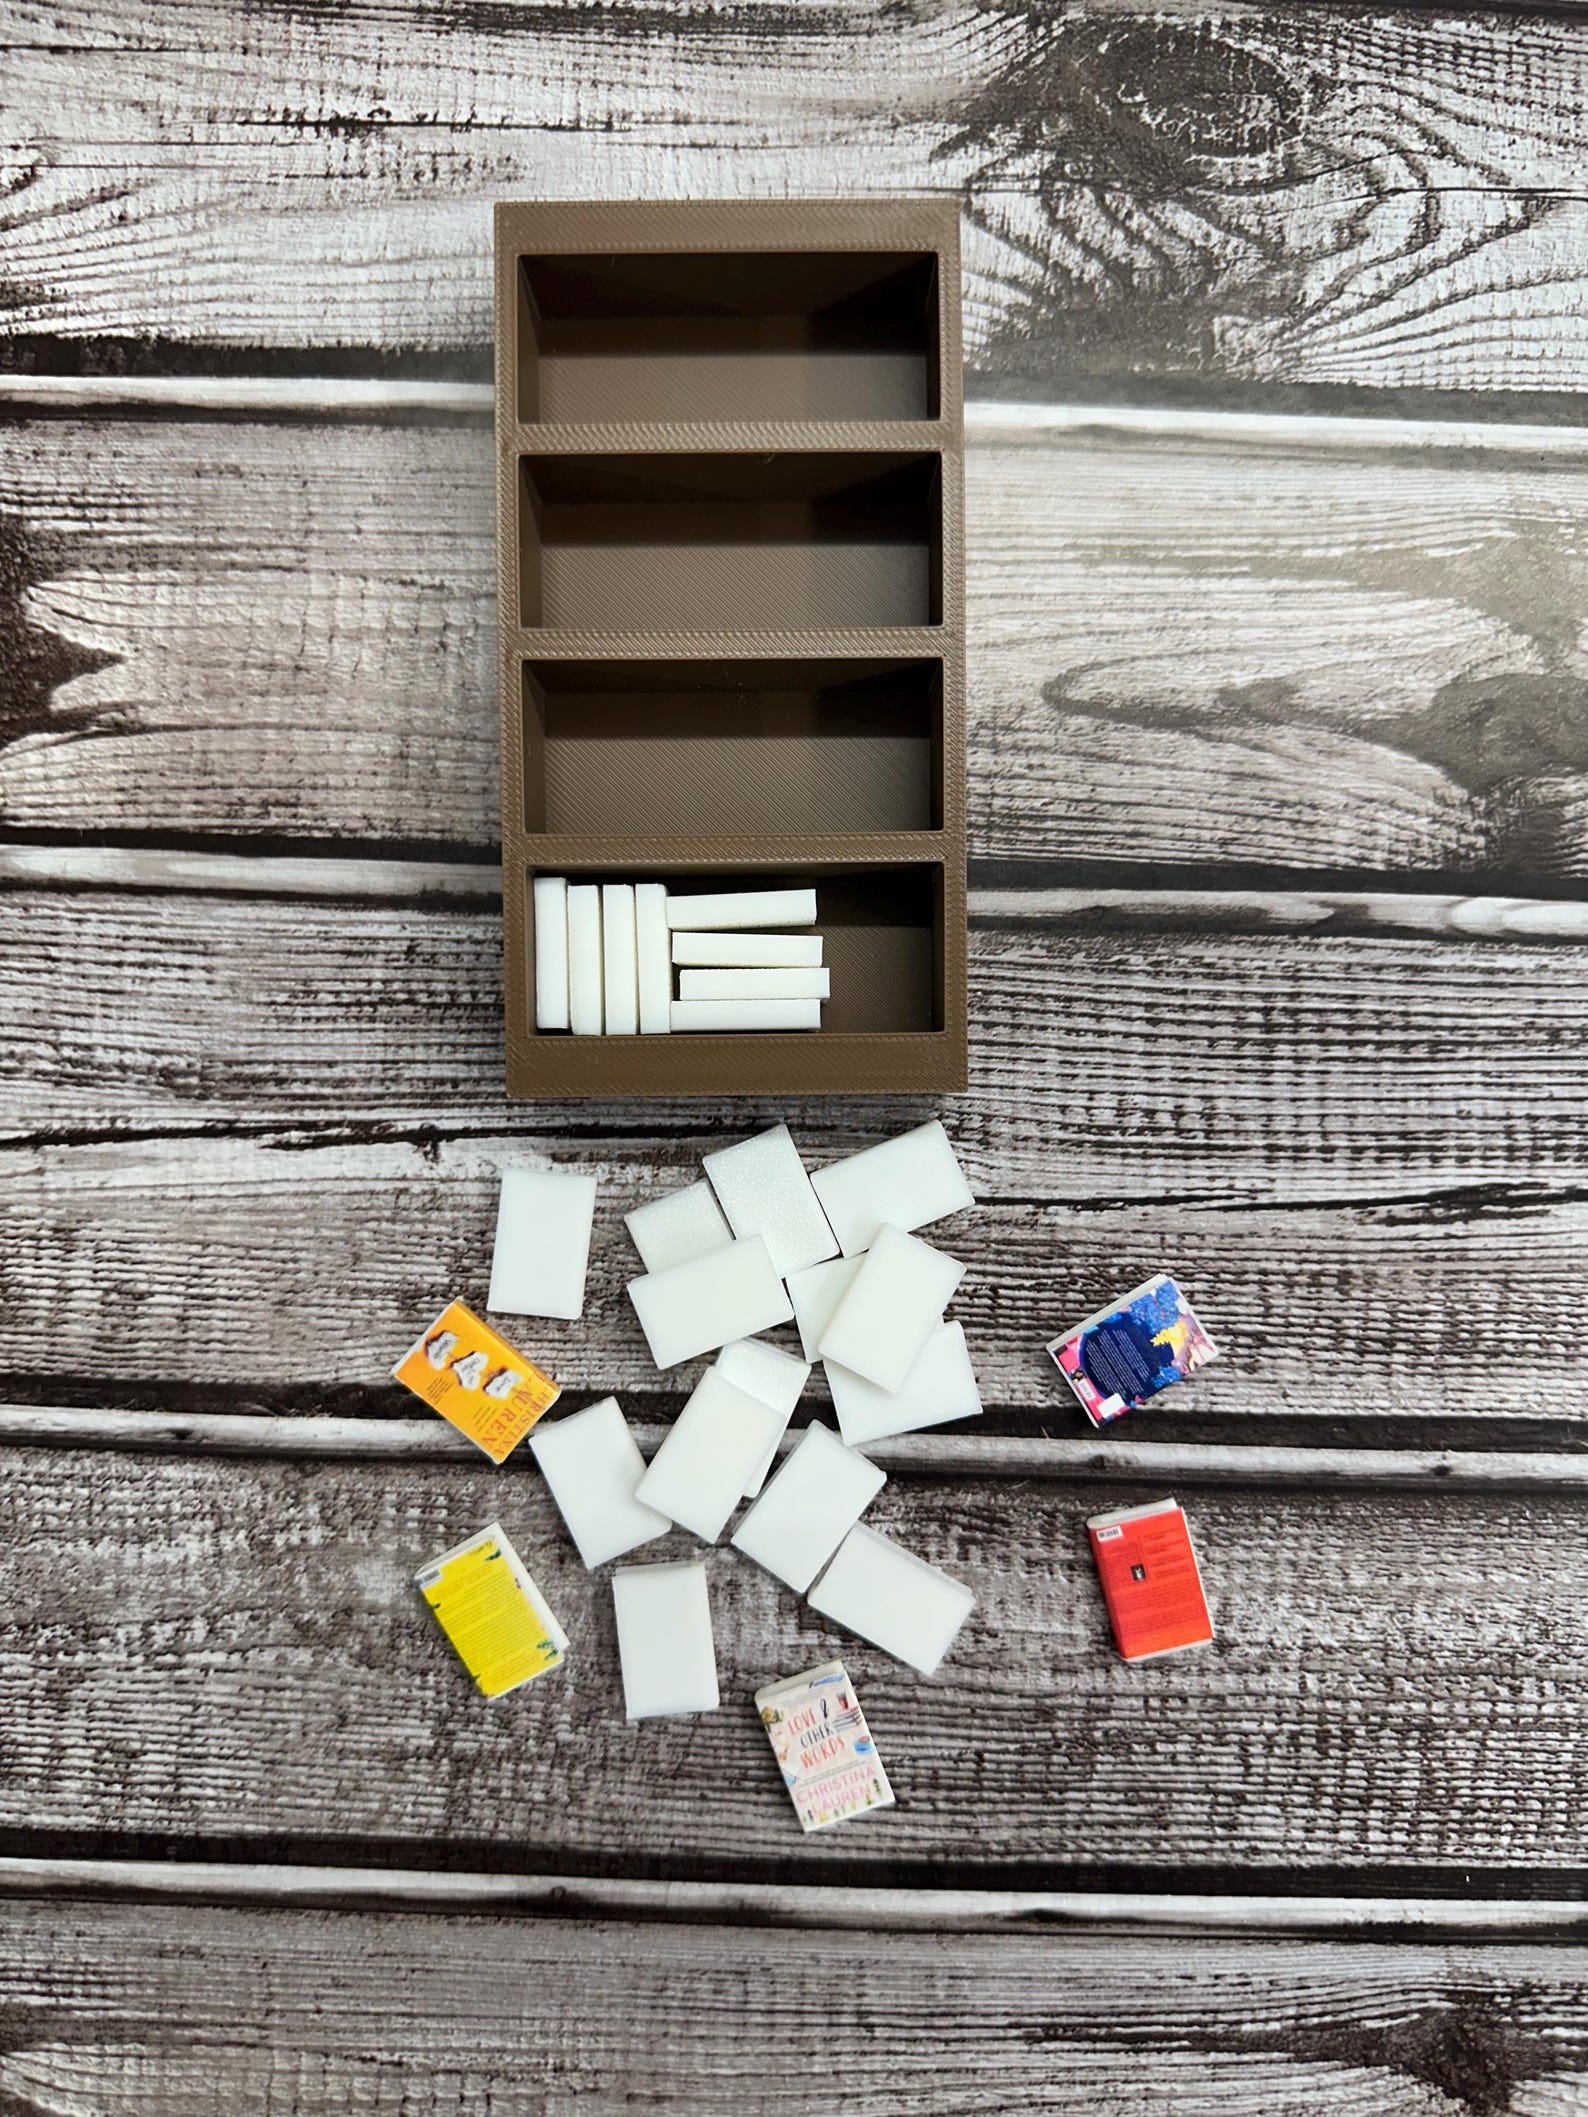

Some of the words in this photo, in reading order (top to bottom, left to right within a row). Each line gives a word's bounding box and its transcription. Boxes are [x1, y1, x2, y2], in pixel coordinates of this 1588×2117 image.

[479, 1372, 545, 1447] LAUREN
[787, 1708, 816, 1735] LOVE
[801, 1722, 834, 1748] OTHER
[801, 1736, 845, 1769] WORDS
[796, 1766, 877, 1804] CHRISTINA
[812, 1784, 872, 1815] LAUREN
